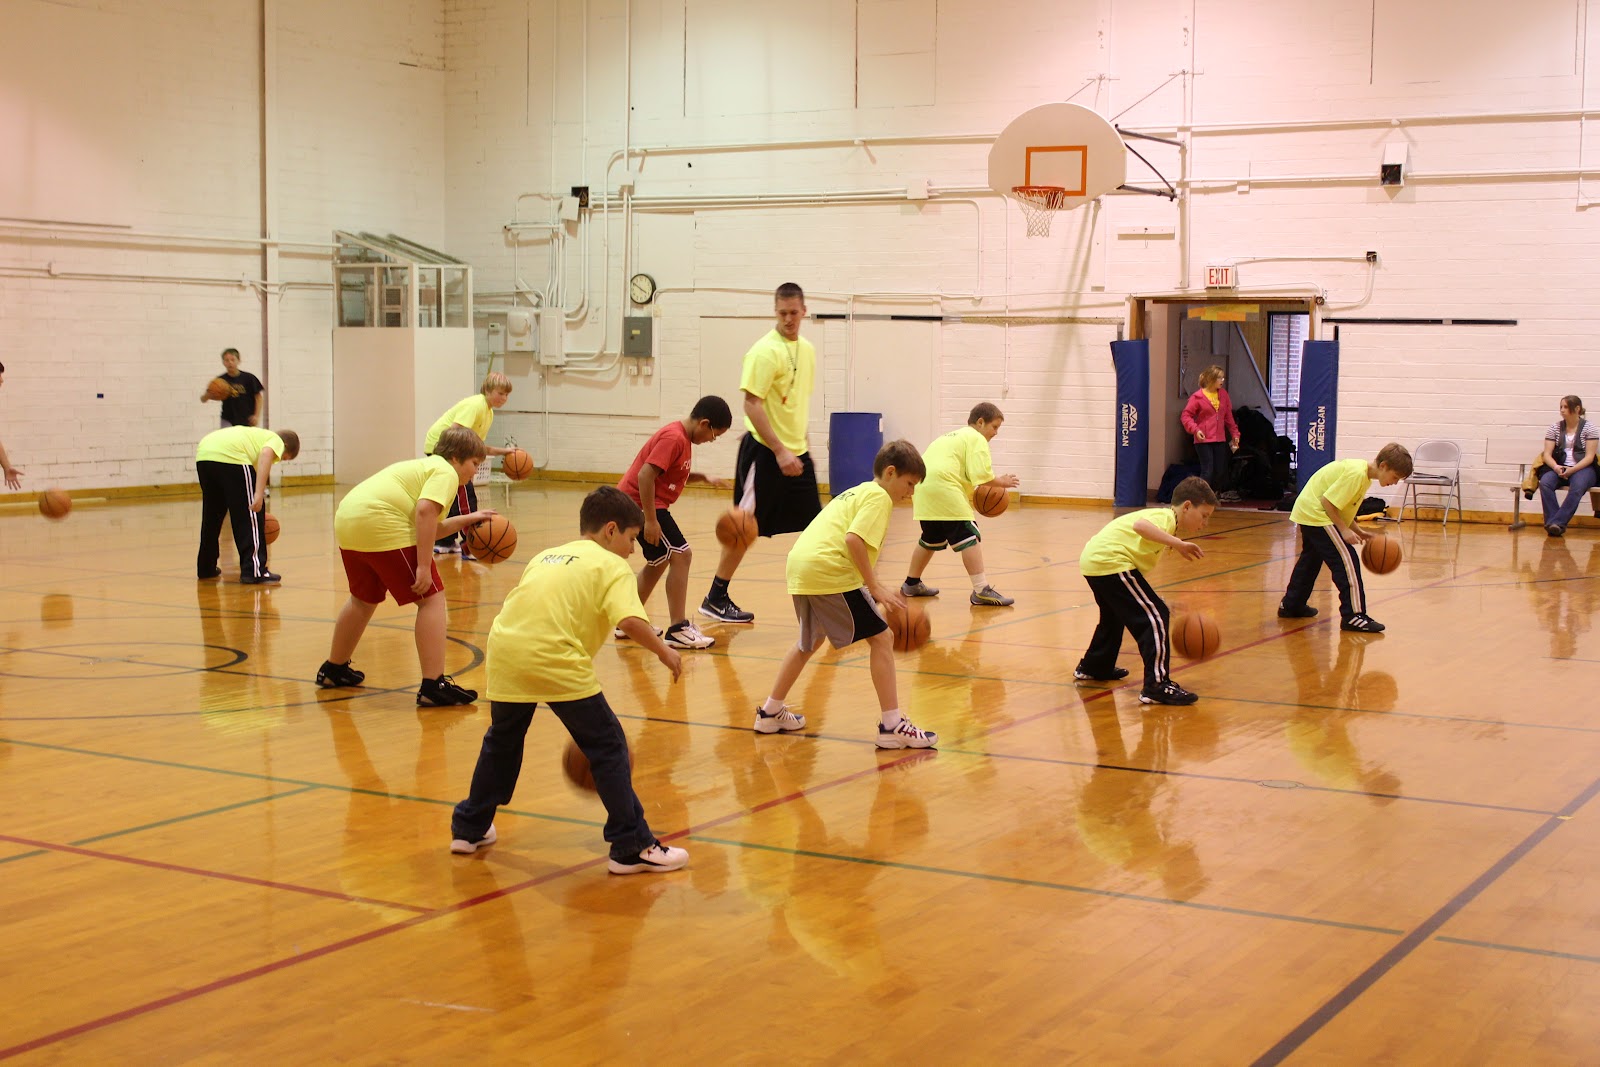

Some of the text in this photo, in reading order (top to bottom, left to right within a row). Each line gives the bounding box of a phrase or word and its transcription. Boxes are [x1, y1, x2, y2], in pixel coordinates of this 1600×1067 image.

[1209, 268, 1230, 285] EXIT
[1121, 403, 1129, 447] AMERICAN
[1317, 405, 1326, 451] AMERICAN
